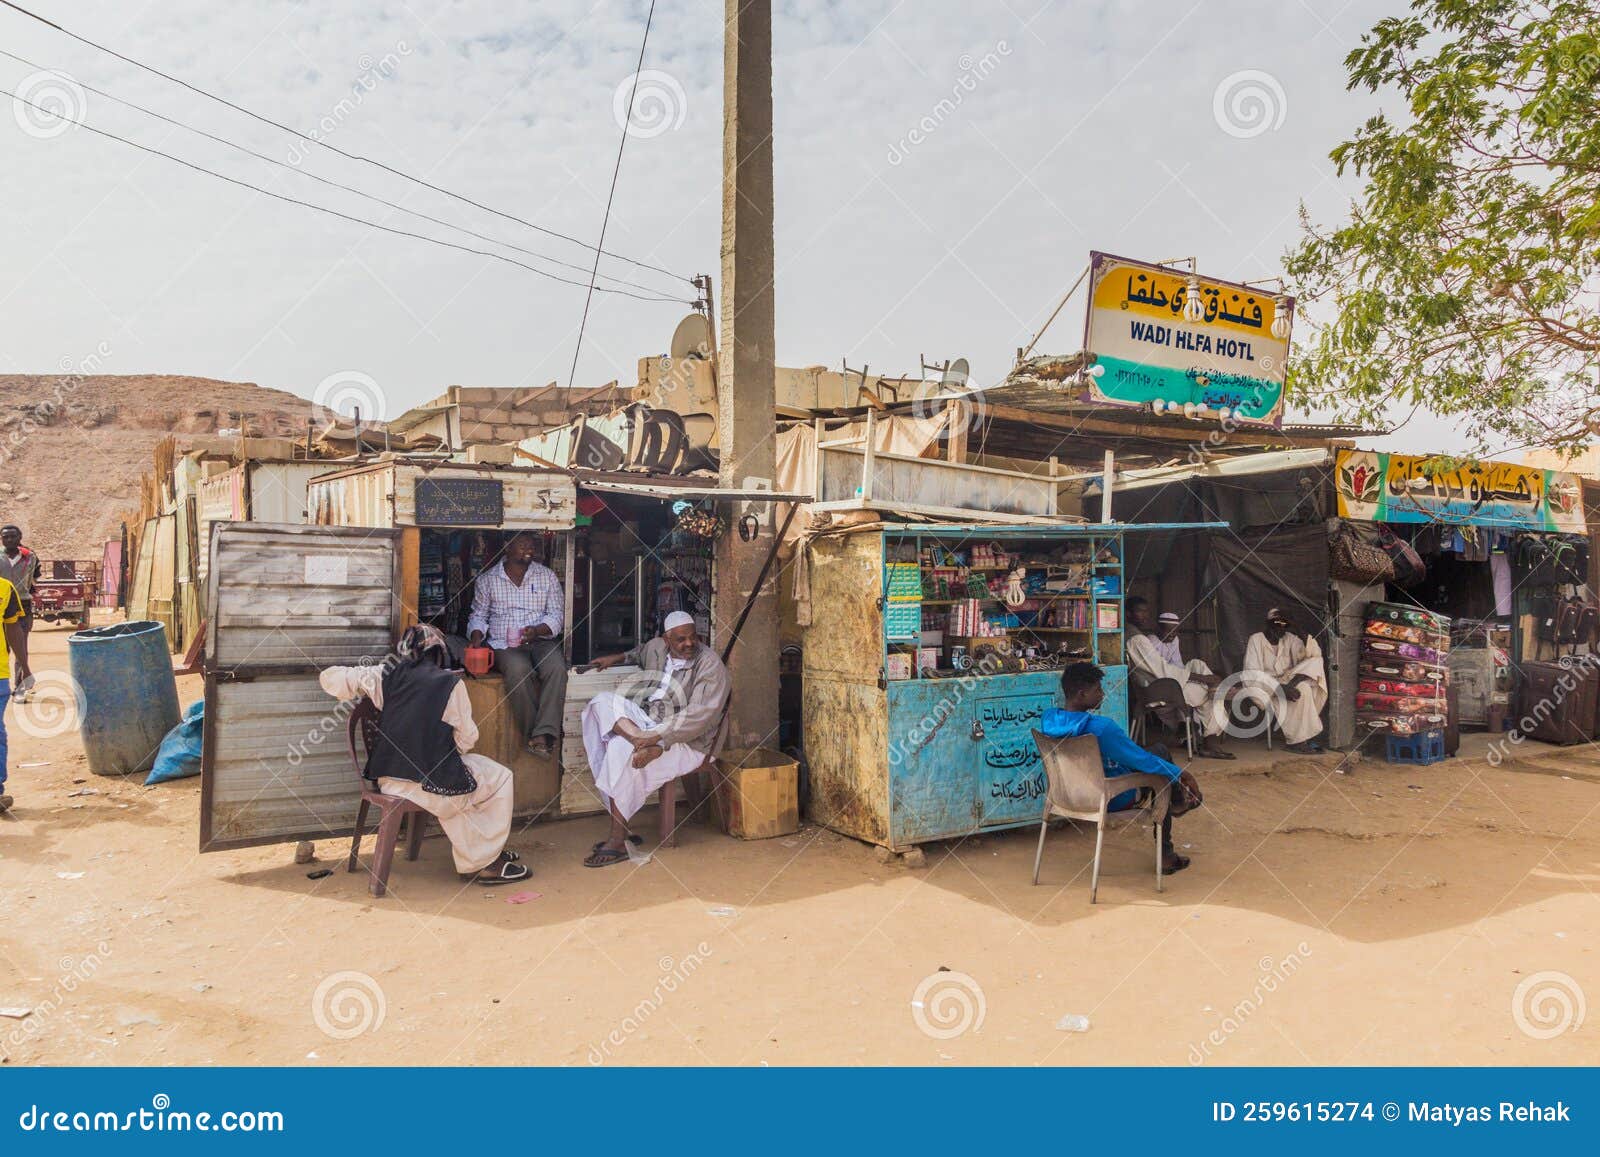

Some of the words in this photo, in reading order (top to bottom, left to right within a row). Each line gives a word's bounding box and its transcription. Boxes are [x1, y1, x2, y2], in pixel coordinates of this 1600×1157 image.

[1127, 274, 1168, 307] حلفا
[1203, 287, 1263, 328] فندق
[1130, 320, 1171, 347] WADI
[1175, 330, 1212, 354] HLFA
[1216, 338, 1254, 361] HOTL
